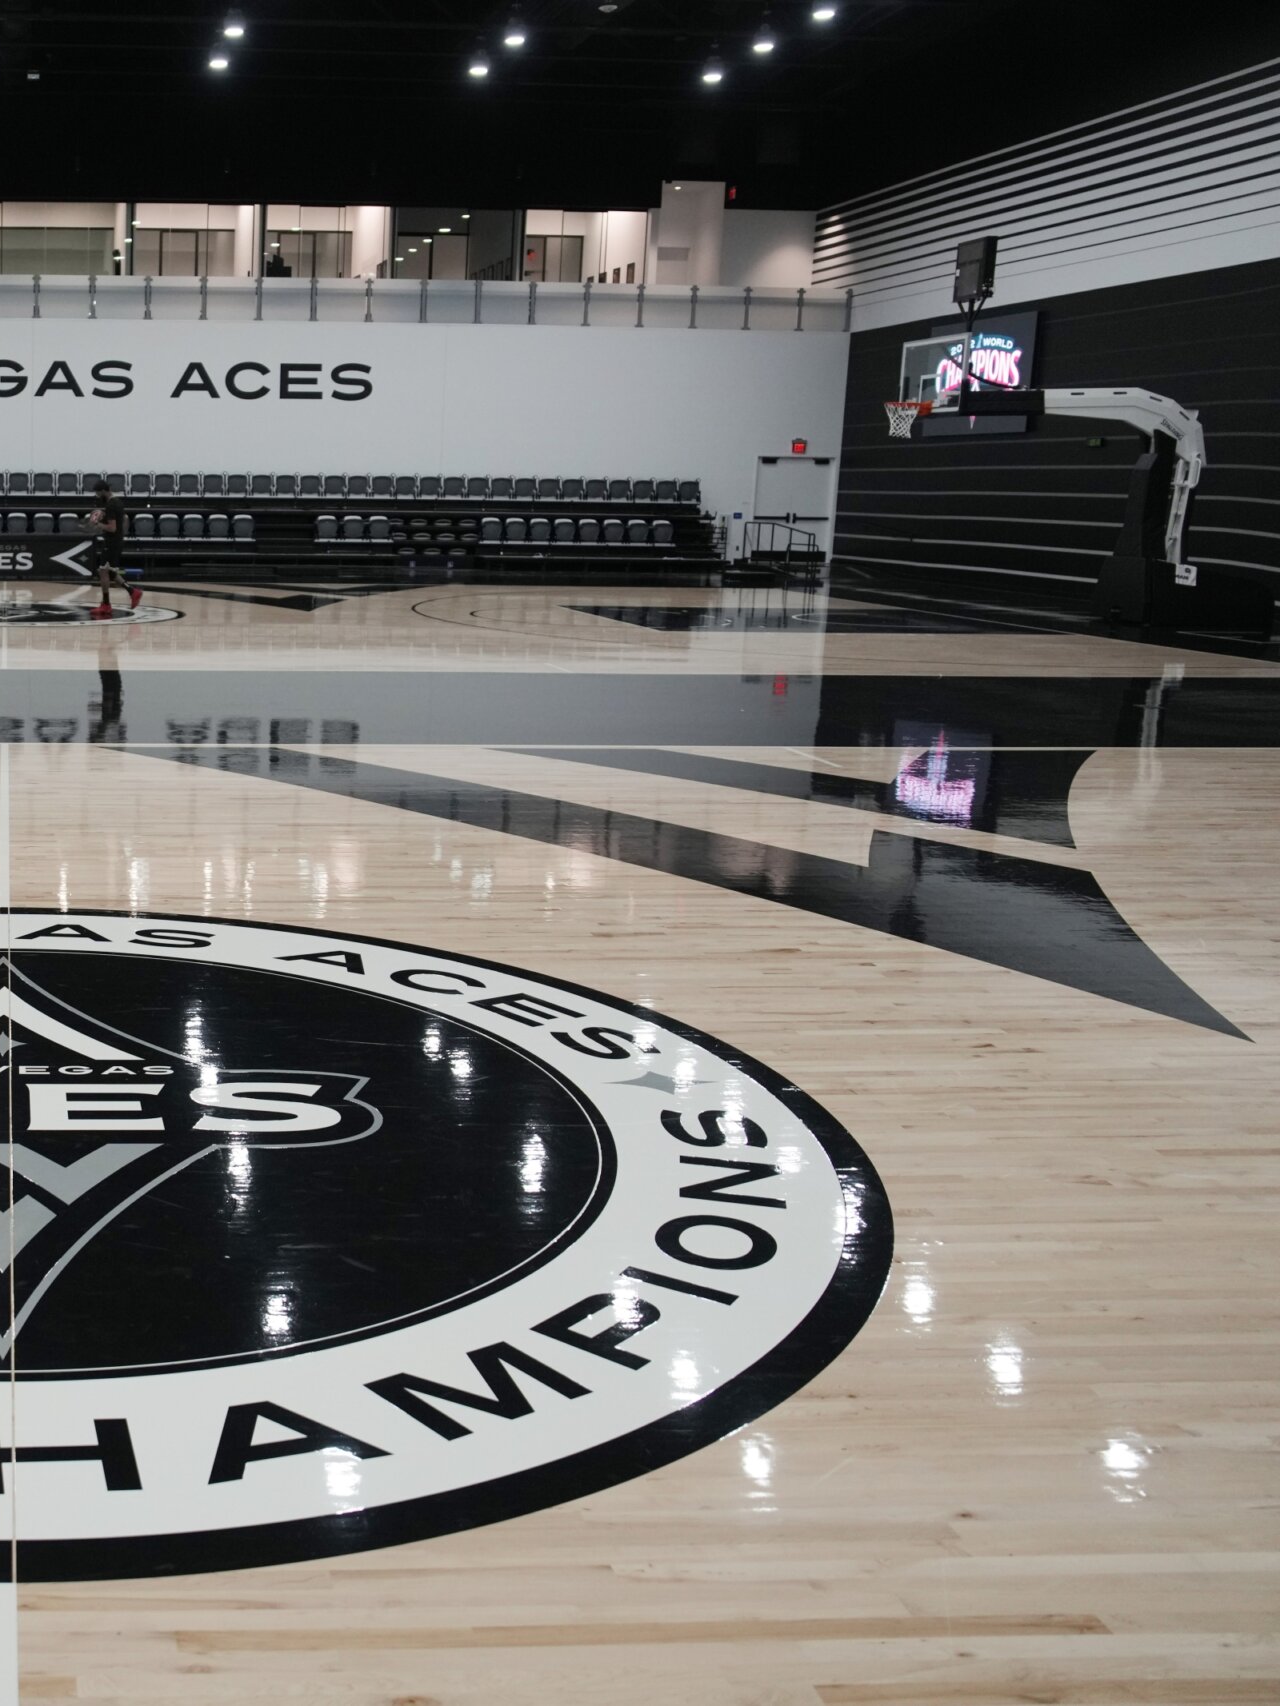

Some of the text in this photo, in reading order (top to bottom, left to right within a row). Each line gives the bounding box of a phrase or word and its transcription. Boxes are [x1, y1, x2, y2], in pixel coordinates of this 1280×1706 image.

[950, 337, 1014, 357] 202 WORLD
[170, 361, 373, 401] ACES
[273, 949, 661, 1062] ACES
